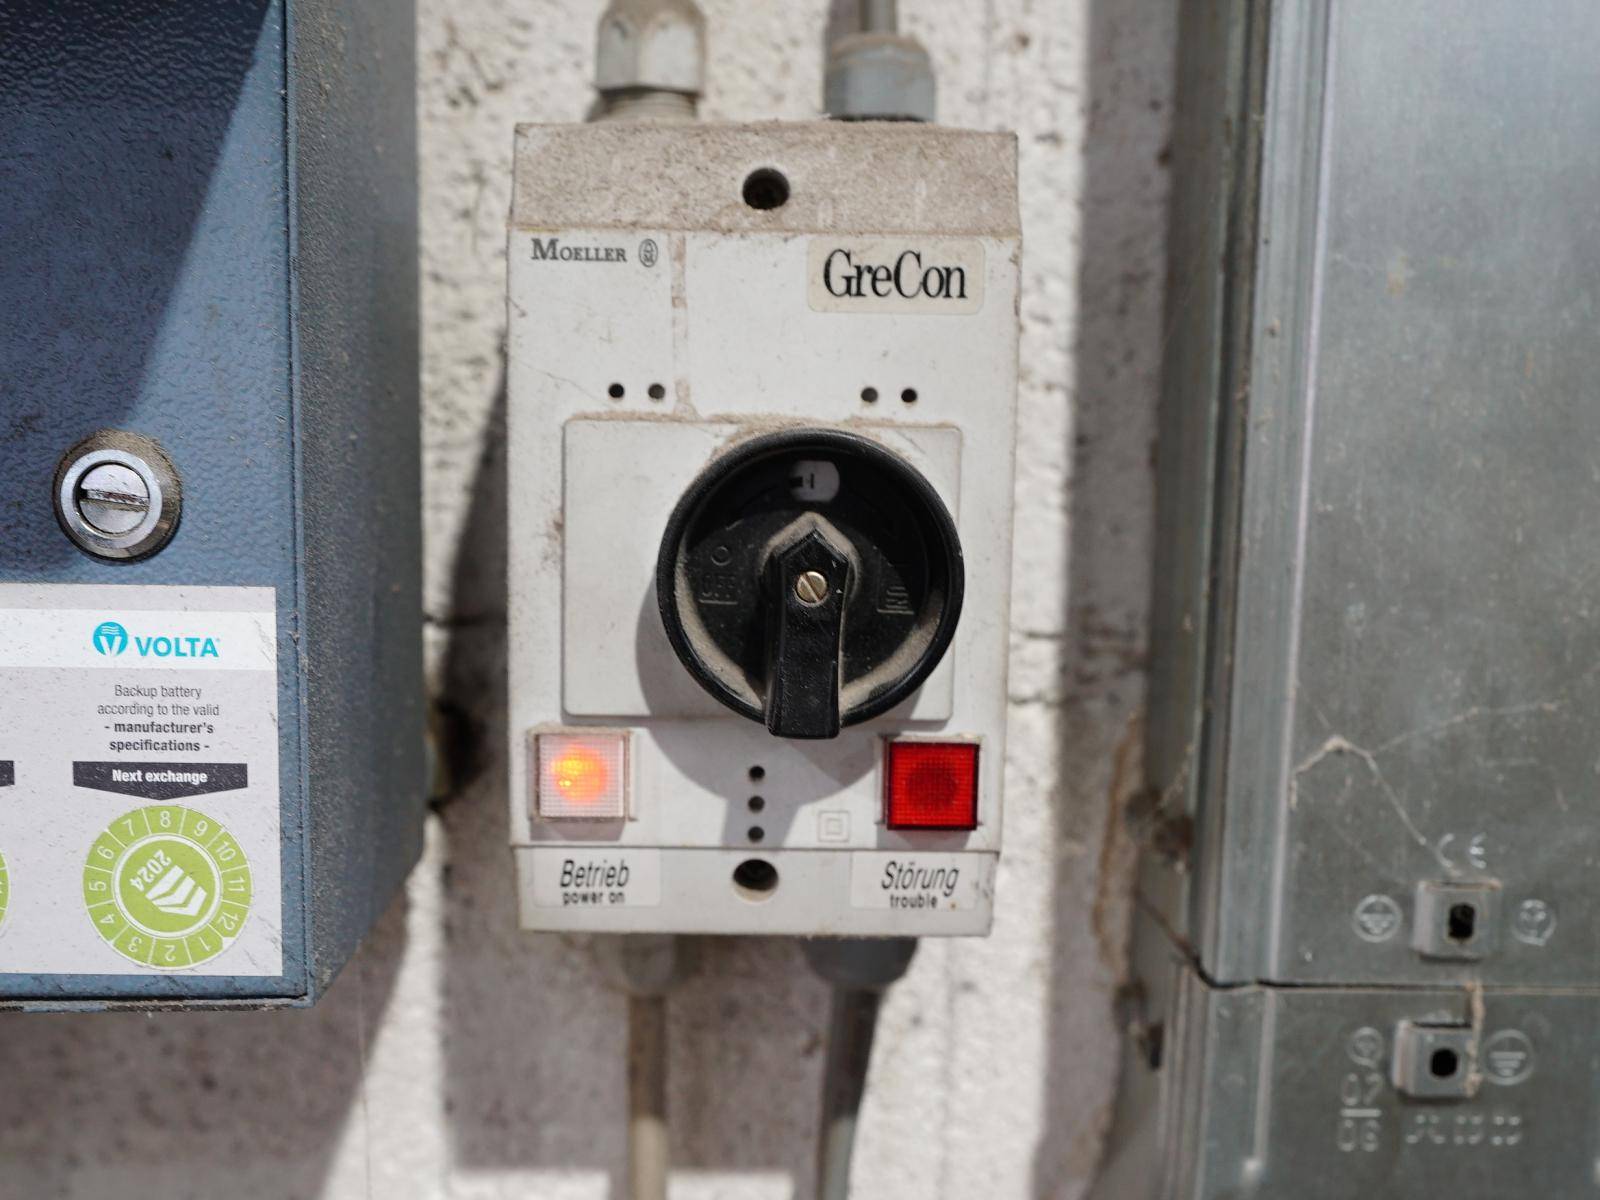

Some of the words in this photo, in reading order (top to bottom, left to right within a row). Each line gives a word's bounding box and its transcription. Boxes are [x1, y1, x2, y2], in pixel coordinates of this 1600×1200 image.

[823, 249, 968, 300] GreCon
[135, 636, 219, 658] VOLTA
[115, 684, 157, 699] Backup
[161, 684, 202, 700] battery
[97, 703, 154, 717] according
[157, 705, 168, 716] to
[171, 703, 190, 716] the
[193, 704, 219, 716] valid
[114, 722, 214, 734] manufacturer's
[109, 740, 200, 753] specifications
[112, 768, 142, 783] Next
[145, 769, 208, 785] exchange
[122, 818, 136, 836] 7
[160, 810, 171, 828] 8
[194, 819, 209, 836] 9
[97, 846, 115, 860] 6
[215, 841, 236, 862] 10
[130, 849, 172, 892] 2024
[560, 859, 630, 888] Betrieb
[881, 860, 960, 897] Störung
[89, 880, 107, 892] 5
[228, 876, 245, 892] 11
[563, 892, 603, 905] power
[609, 892, 625, 904] on
[889, 894, 938, 908] trouble
[100, 912, 115, 925] 4
[219, 911, 238, 931] 12
[128, 936, 143, 952] 3
[199, 937, 212, 952] 1
[164, 944, 176, 962] 2
